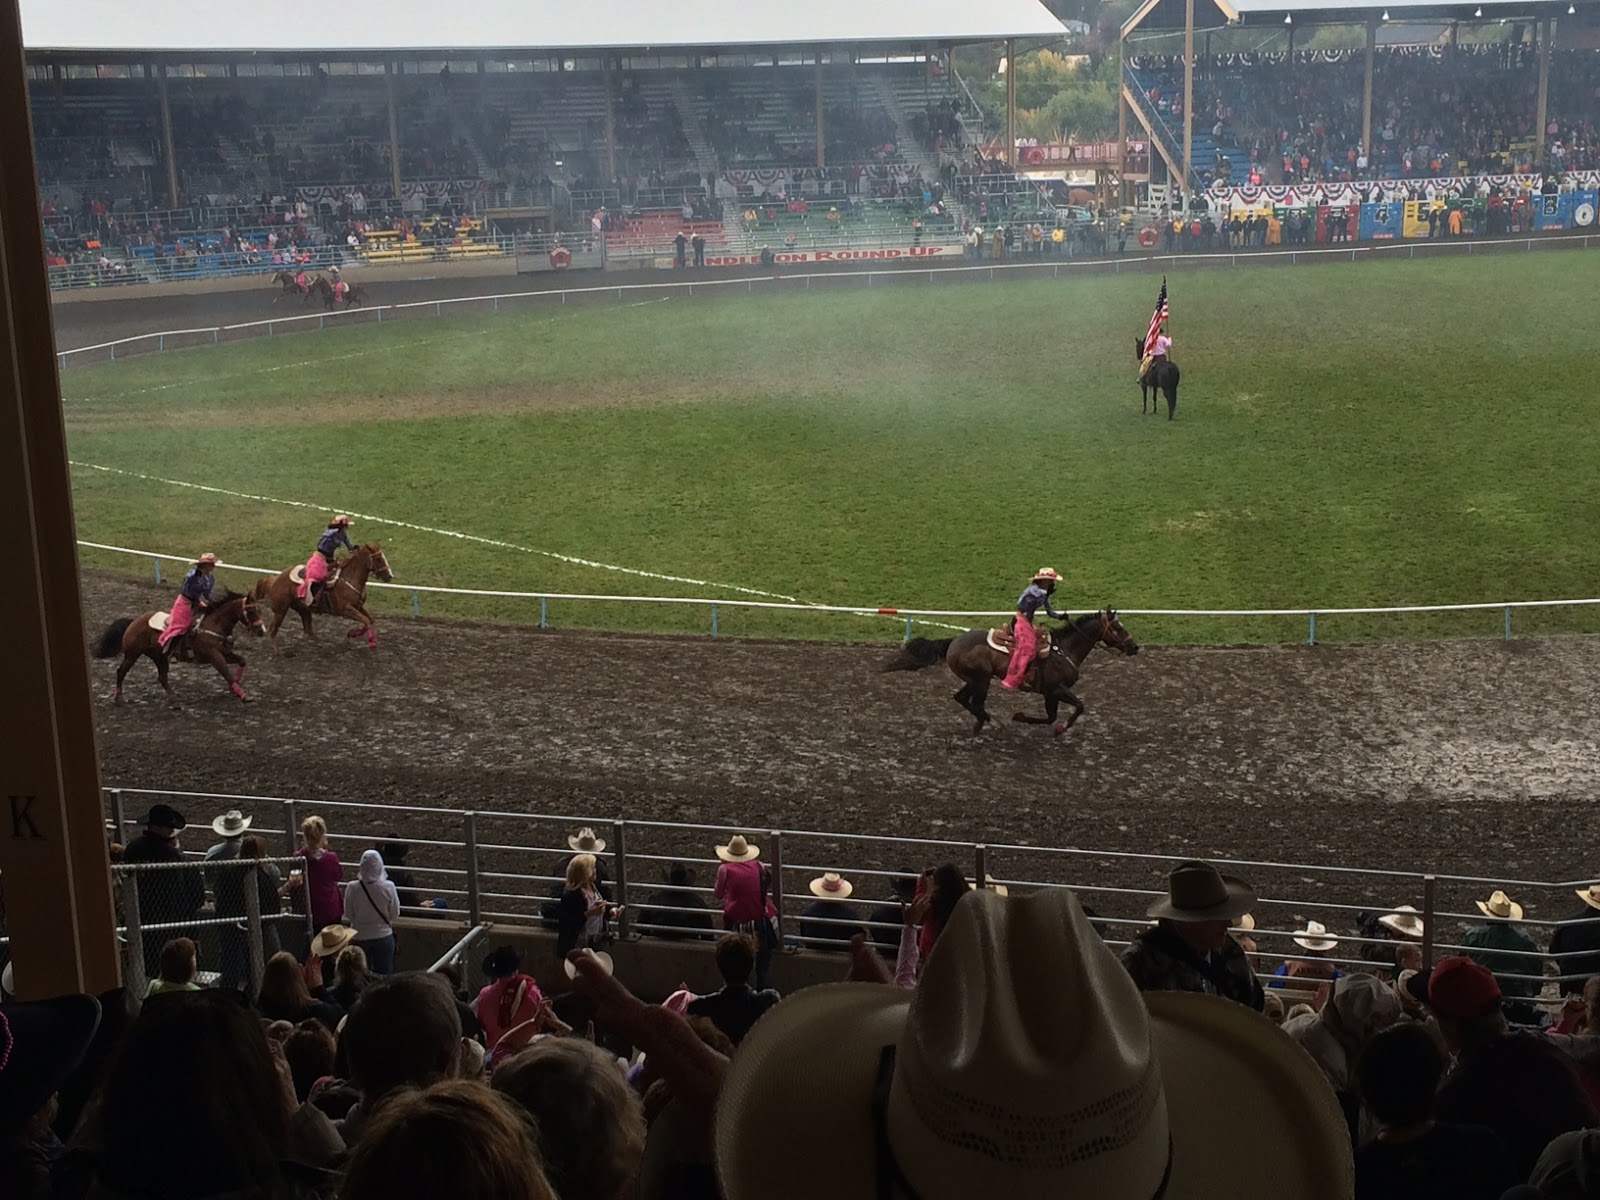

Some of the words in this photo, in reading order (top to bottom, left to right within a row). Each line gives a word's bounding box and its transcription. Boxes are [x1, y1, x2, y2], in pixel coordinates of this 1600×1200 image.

[1373, 203, 1390, 225] 4
[672, 253, 807, 267] NDLEON
[8, 795, 47, 840] K
